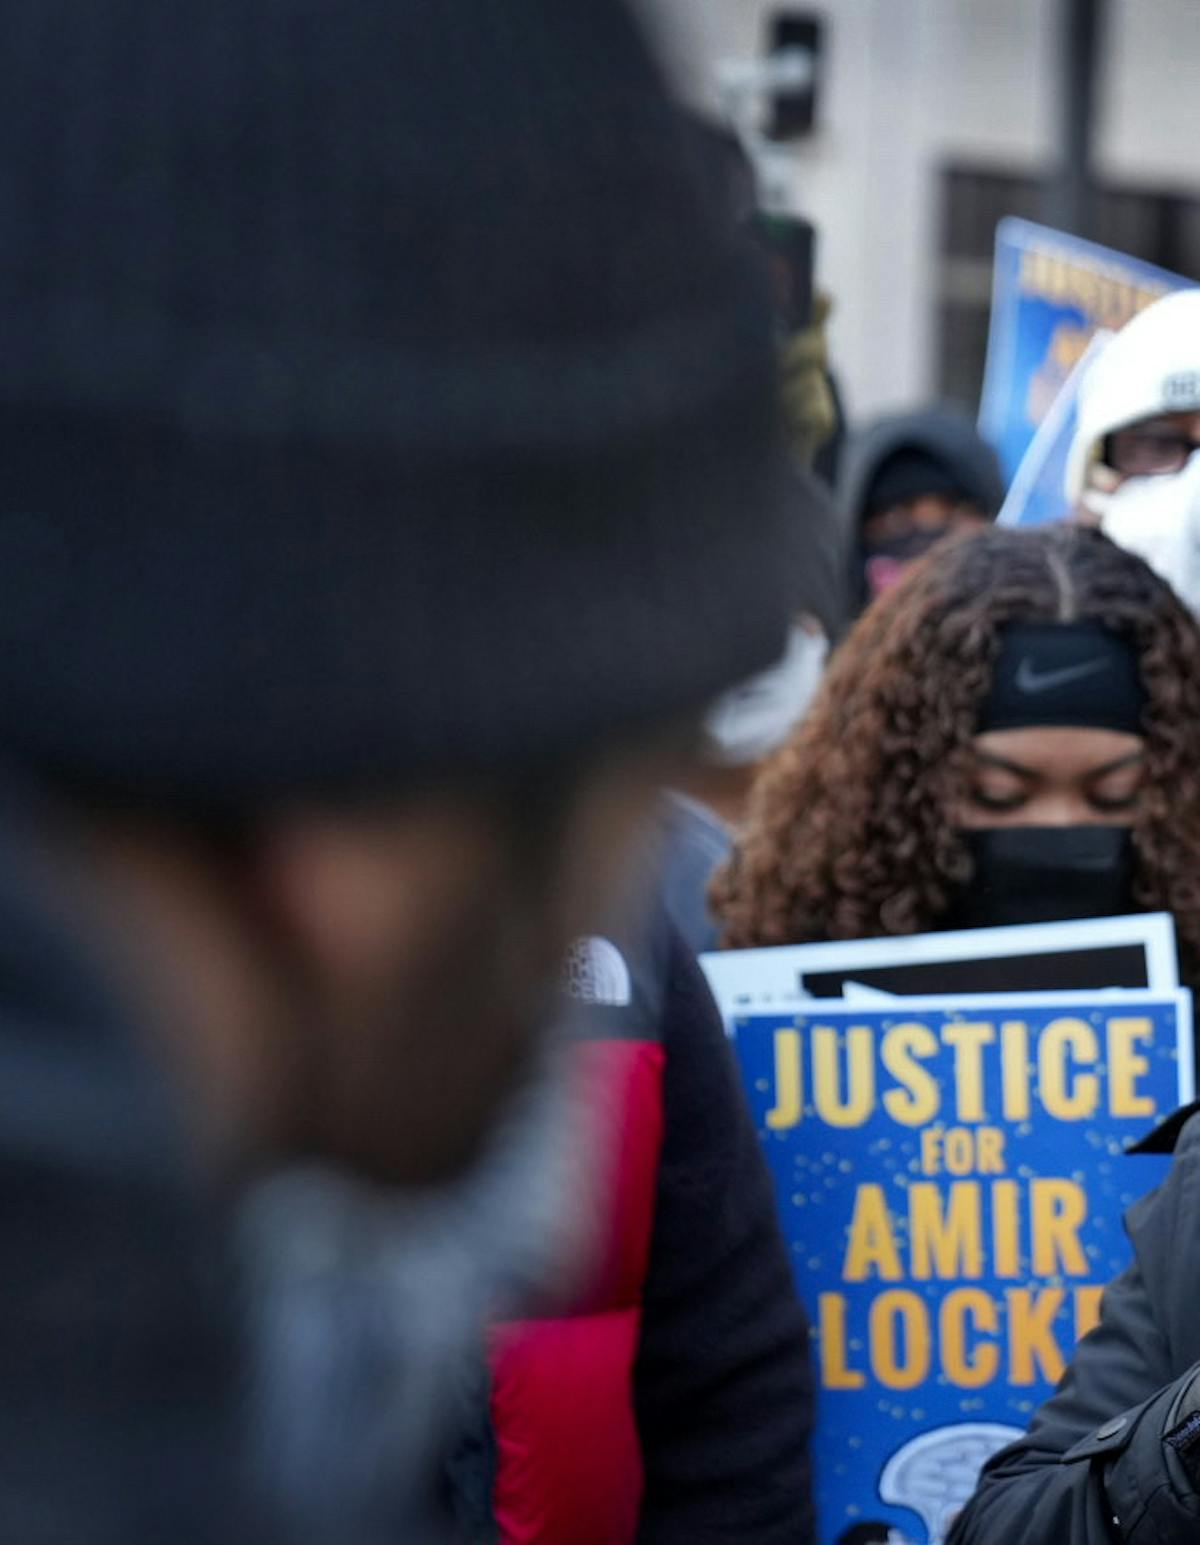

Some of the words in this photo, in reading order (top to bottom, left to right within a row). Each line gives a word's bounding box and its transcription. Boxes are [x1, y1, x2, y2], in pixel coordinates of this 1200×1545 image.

[765, 1017, 1156, 1130] JUSTICE
[920, 1127, 1006, 1175] FOR
[842, 1178, 1088, 1282] AMIR
